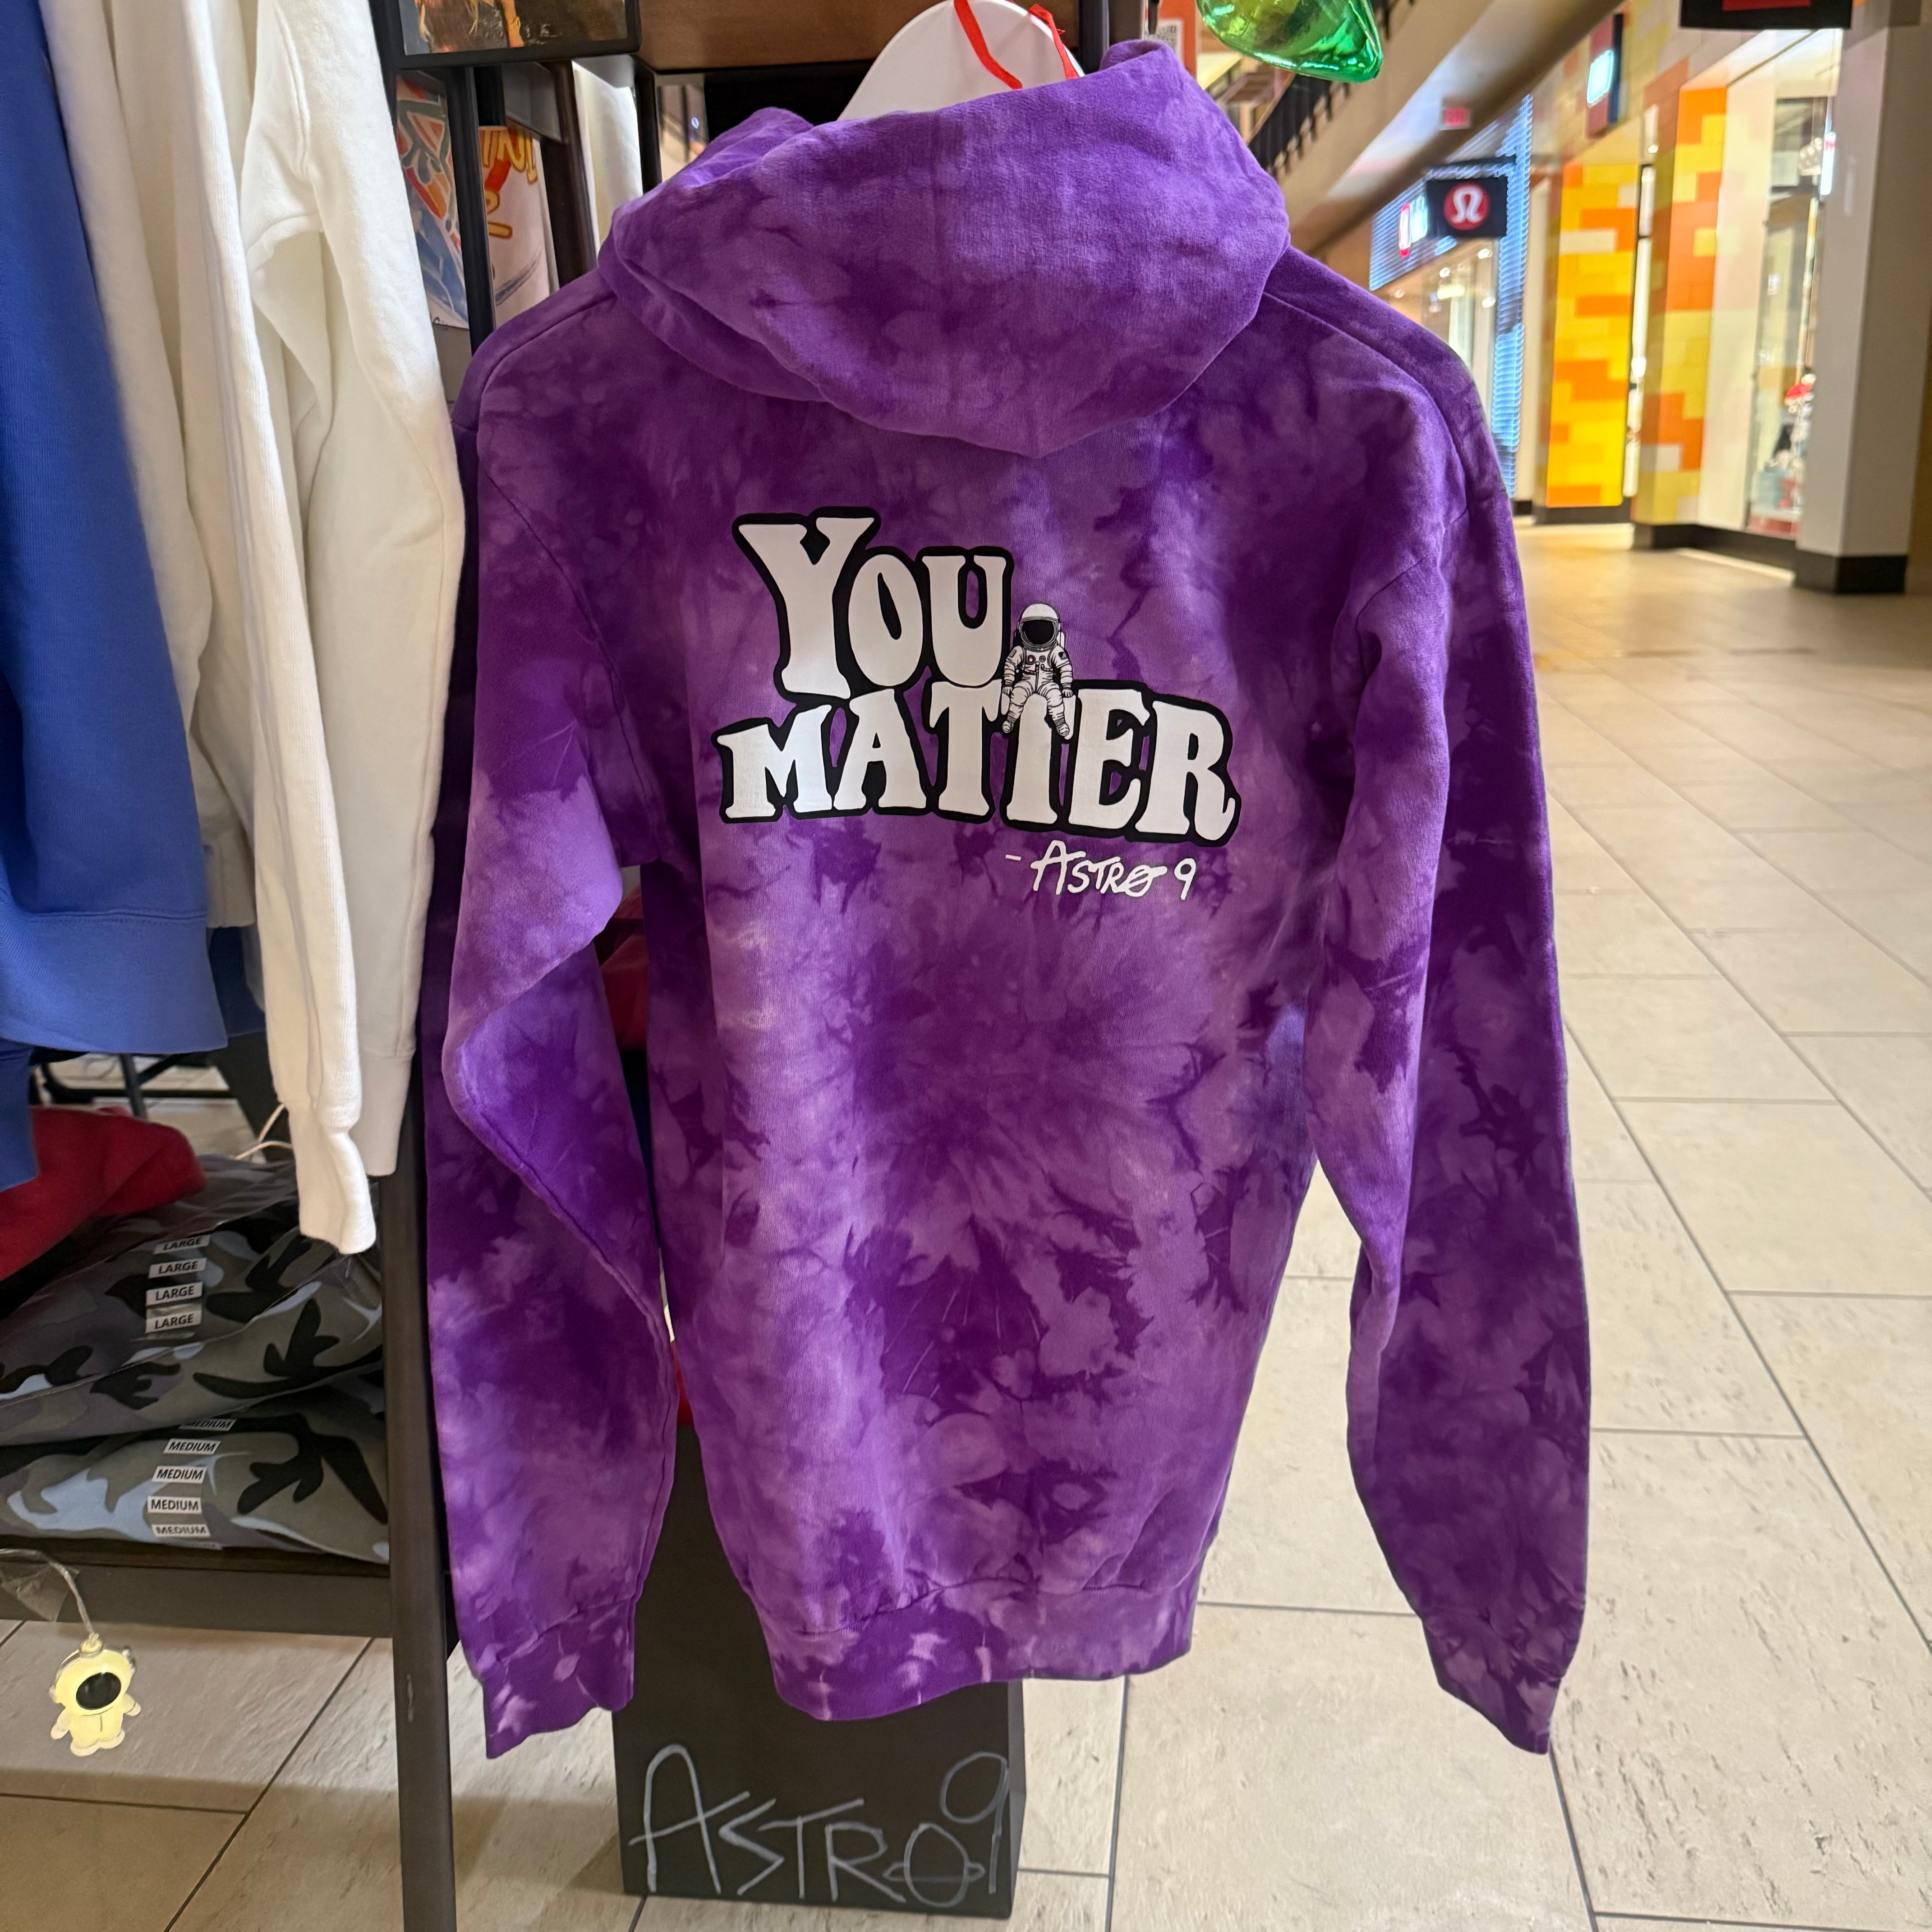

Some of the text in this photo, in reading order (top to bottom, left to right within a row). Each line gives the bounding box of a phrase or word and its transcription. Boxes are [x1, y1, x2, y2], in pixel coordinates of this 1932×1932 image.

[733, 508, 1013, 702] YOU
[713, 679, 1241, 846] MATTER
[1030, 840, 1167, 897] ASTRO
[1174, 858, 1196, 900] 9
[164, 1237, 202, 1251] LARGE
[159, 1261, 198, 1274] LARGE
[156, 1286, 194, 1301] LARGE
[155, 1313, 194, 1329] LARGE
[168, 1441, 217, 1452] MEDIUM
[156, 1469, 203, 1481] MEDIUM
[151, 1499, 199, 1511] MEDIUM
